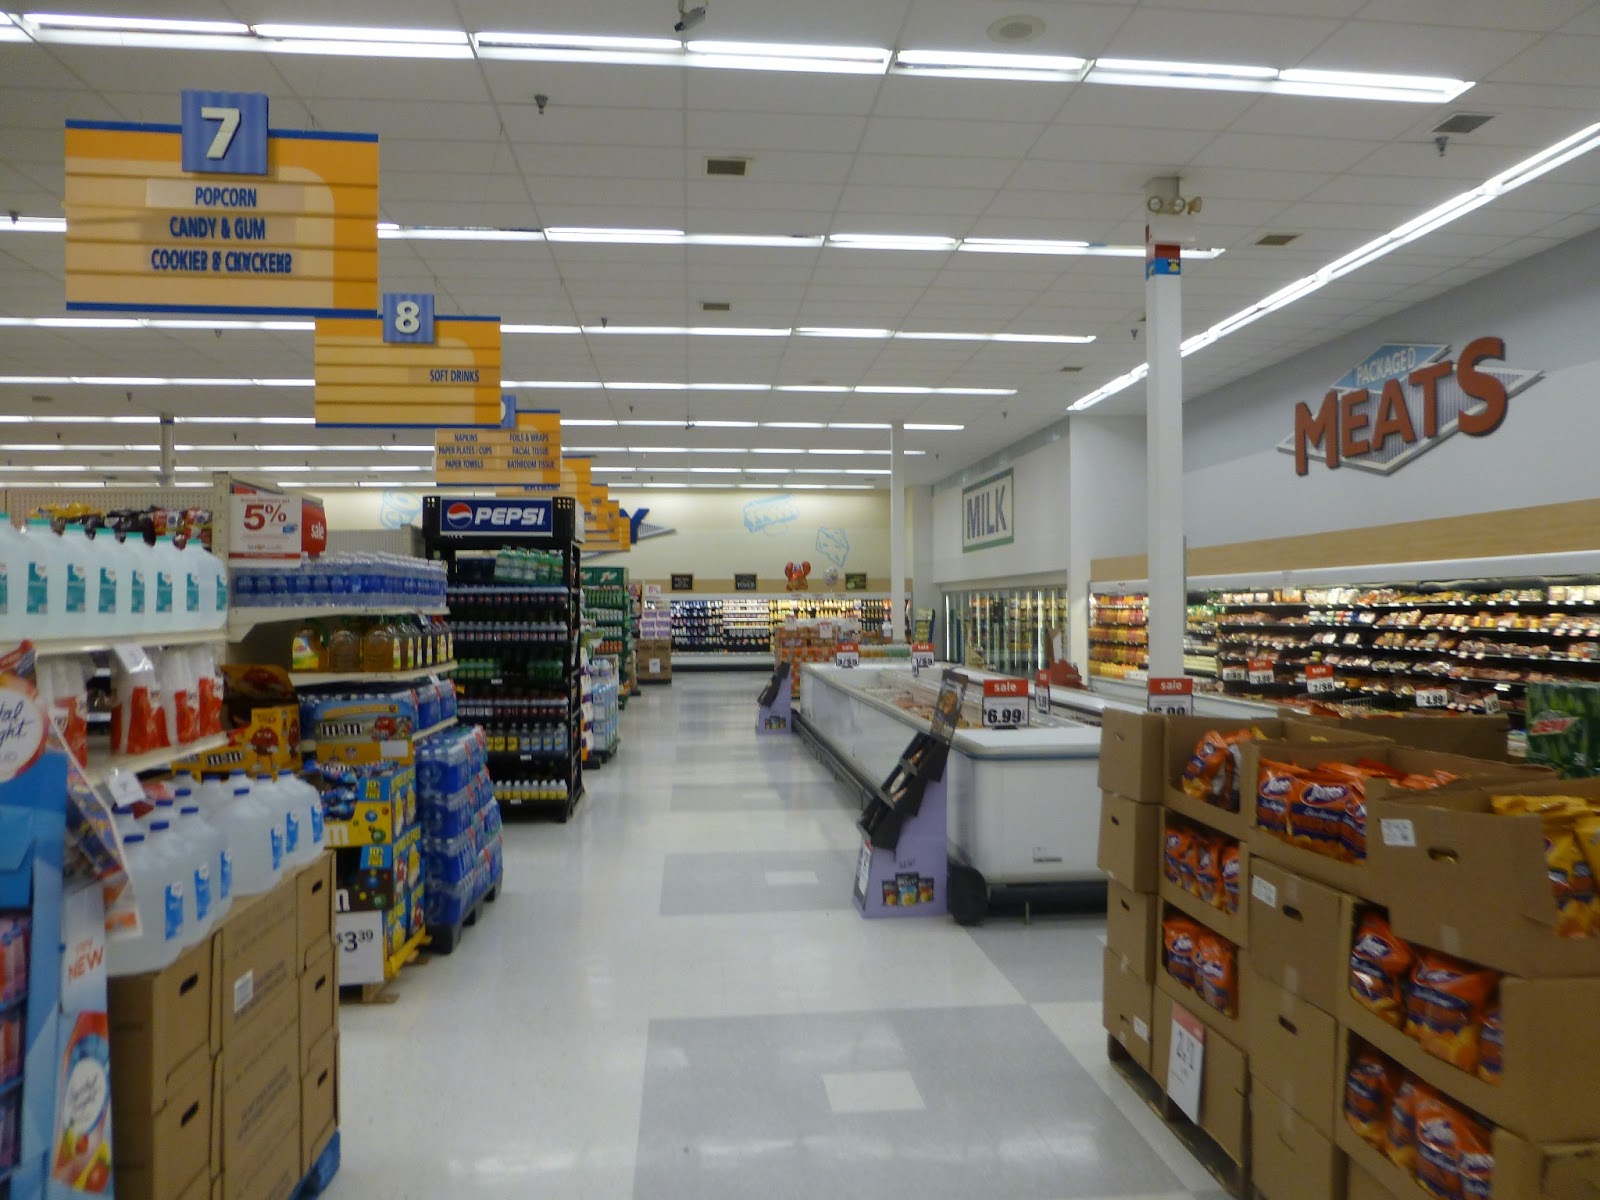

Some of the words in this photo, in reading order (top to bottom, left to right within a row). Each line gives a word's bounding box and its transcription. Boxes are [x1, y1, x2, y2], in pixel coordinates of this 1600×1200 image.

[202, 107, 241, 160] 7
[195, 186, 257, 207] POPCORN
[169, 216, 216, 239] CANDY
[221, 217, 230, 239] &
[234, 218, 265, 240] GUM
[395, 300, 420, 334] 8
[1357, 347, 1416, 386] PACKAGED
[430, 369, 449, 382] SOFT
[451, 370, 480, 383] DRINKS
[1295, 336, 1508, 476] MEATS
[454, 433, 478, 442] NAPKINS
[439, 446, 456, 455] PAPER
[456, 446, 474, 455] PLATES
[479, 446, 492, 455] CUPS
[513, 446, 530, 455] FACIAL
[532, 446, 549, 455] TISSUE
[445, 460, 461, 468] PAPER
[463, 460, 483, 469] TOWELS
[507, 460, 537, 468] BATHROOM
[538, 460, 555, 469] TISSUE
[243, 504, 287, 531] 5%
[474, 507, 545, 526] PEPSI
[967, 484, 1007, 539] MILK
[1311, 666, 1326, 674] sale
[993, 681, 1017, 693] sale
[1160, 680, 1183, 691] sale
